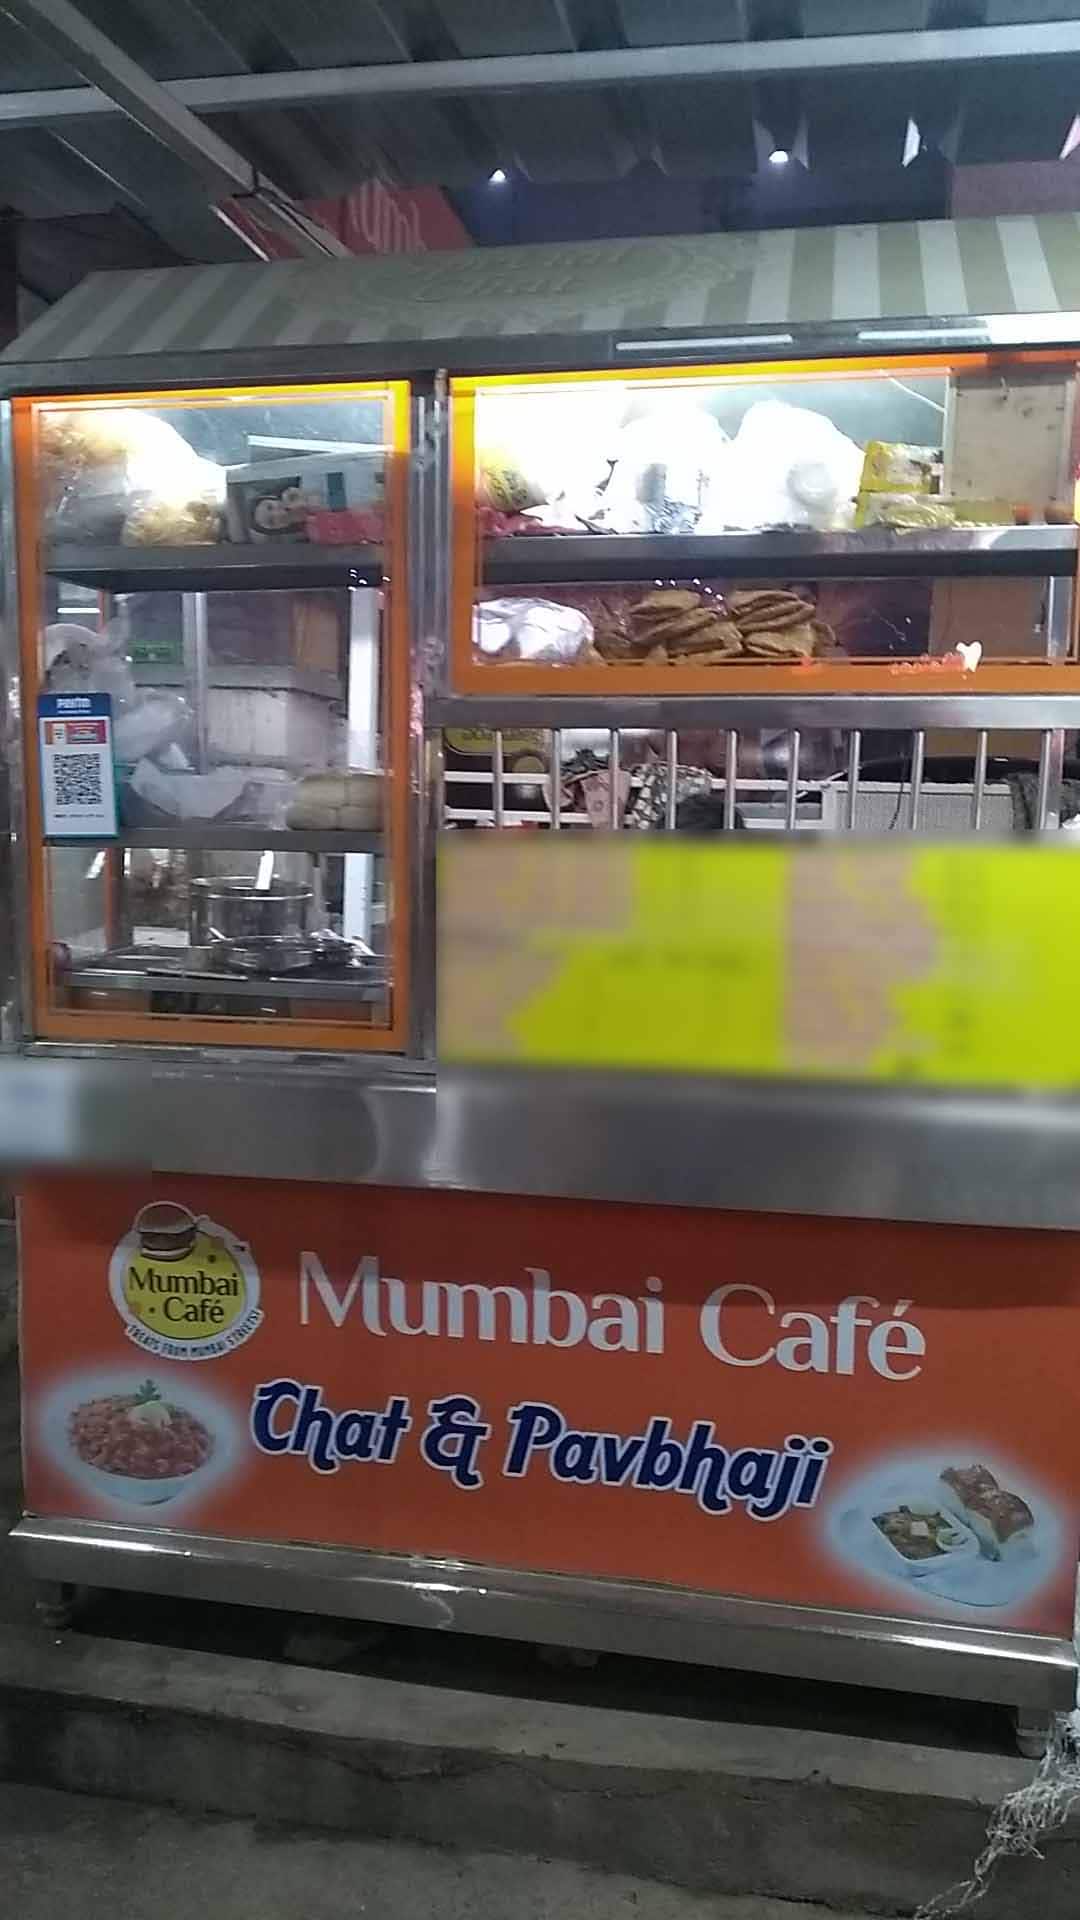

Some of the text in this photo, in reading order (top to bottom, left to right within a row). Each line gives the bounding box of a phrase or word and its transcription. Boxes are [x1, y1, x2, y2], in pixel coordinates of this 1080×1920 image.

[129, 1266, 239, 1296] Mumbai
[163, 1296, 224, 1323] Café
[300, 1251, 926, 1381] Mumbai Café
[251, 1378, 833, 1521] Chat & Pavbhaji
